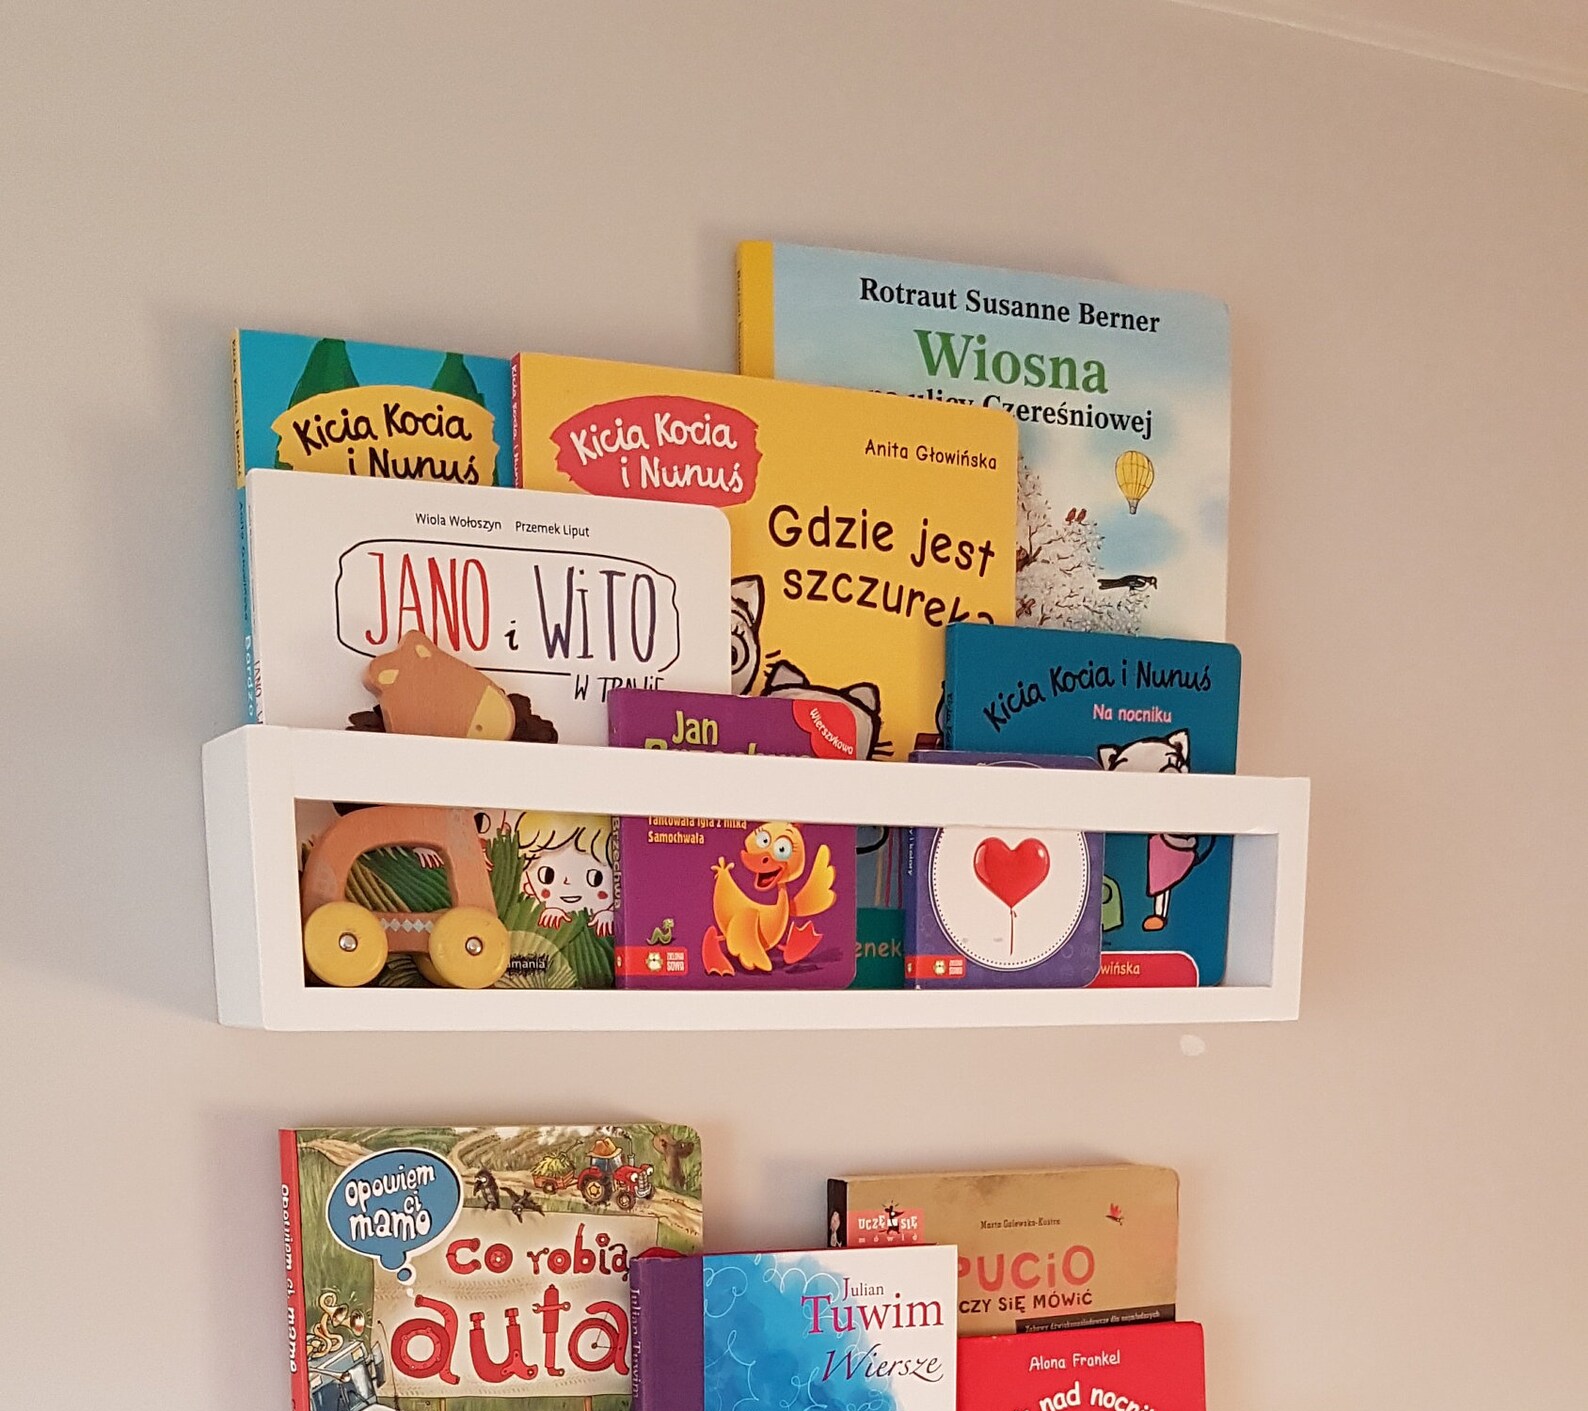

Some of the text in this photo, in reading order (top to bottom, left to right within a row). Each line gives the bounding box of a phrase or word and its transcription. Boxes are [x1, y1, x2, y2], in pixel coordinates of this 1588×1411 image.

[859, 276, 1160, 334] Rotraut Susanne Berner
[914, 329, 1109, 394] Wiosna
[293, 402, 473, 457] Kicia Kocia
[570, 412, 738, 466] Kicia Kocia
[347, 446, 480, 485] i Nunuś
[865, 438, 997, 471] Anita Głowińska
[620, 455, 744, 494] i Nunuś
[415, 512, 590, 538] Wiola Wołoszyn Przemek Liput
[768, 504, 996, 578] Gdzie jest
[365, 551, 489, 652] JANO
[504, 620, 519, 651] i
[983, 680, 1047, 732] Kicia
[1049, 660, 1116, 697] Kocia
[1121, 659, 1127, 687] i
[1136, 660, 1211, 692] Nunuś
[1093, 704, 1172, 724] Na nocniku
[671, 710, 719, 746] Jan
[809, 708, 855, 756] Wierszykowo
[855, 938, 901, 958] enek
[1101, 961, 1140, 975] wińska
[345, 1163, 436, 1214] opowiem
[403, 1190, 422, 1215] ci
[349, 1207, 431, 1242] mamo
[858, 1215, 918, 1230] UCZĘ SIĘ
[526, 1222, 630, 1282] robią
[842, 1277, 885, 1301] Julian
[958, 1298, 992, 1314] CZY
[801, 1292, 945, 1335] Tuwim
[391, 1284, 630, 1385] auta
[822, 1343, 945, 1384] Wiersze
[1028, 1349, 1121, 1372] Alona Frankel
